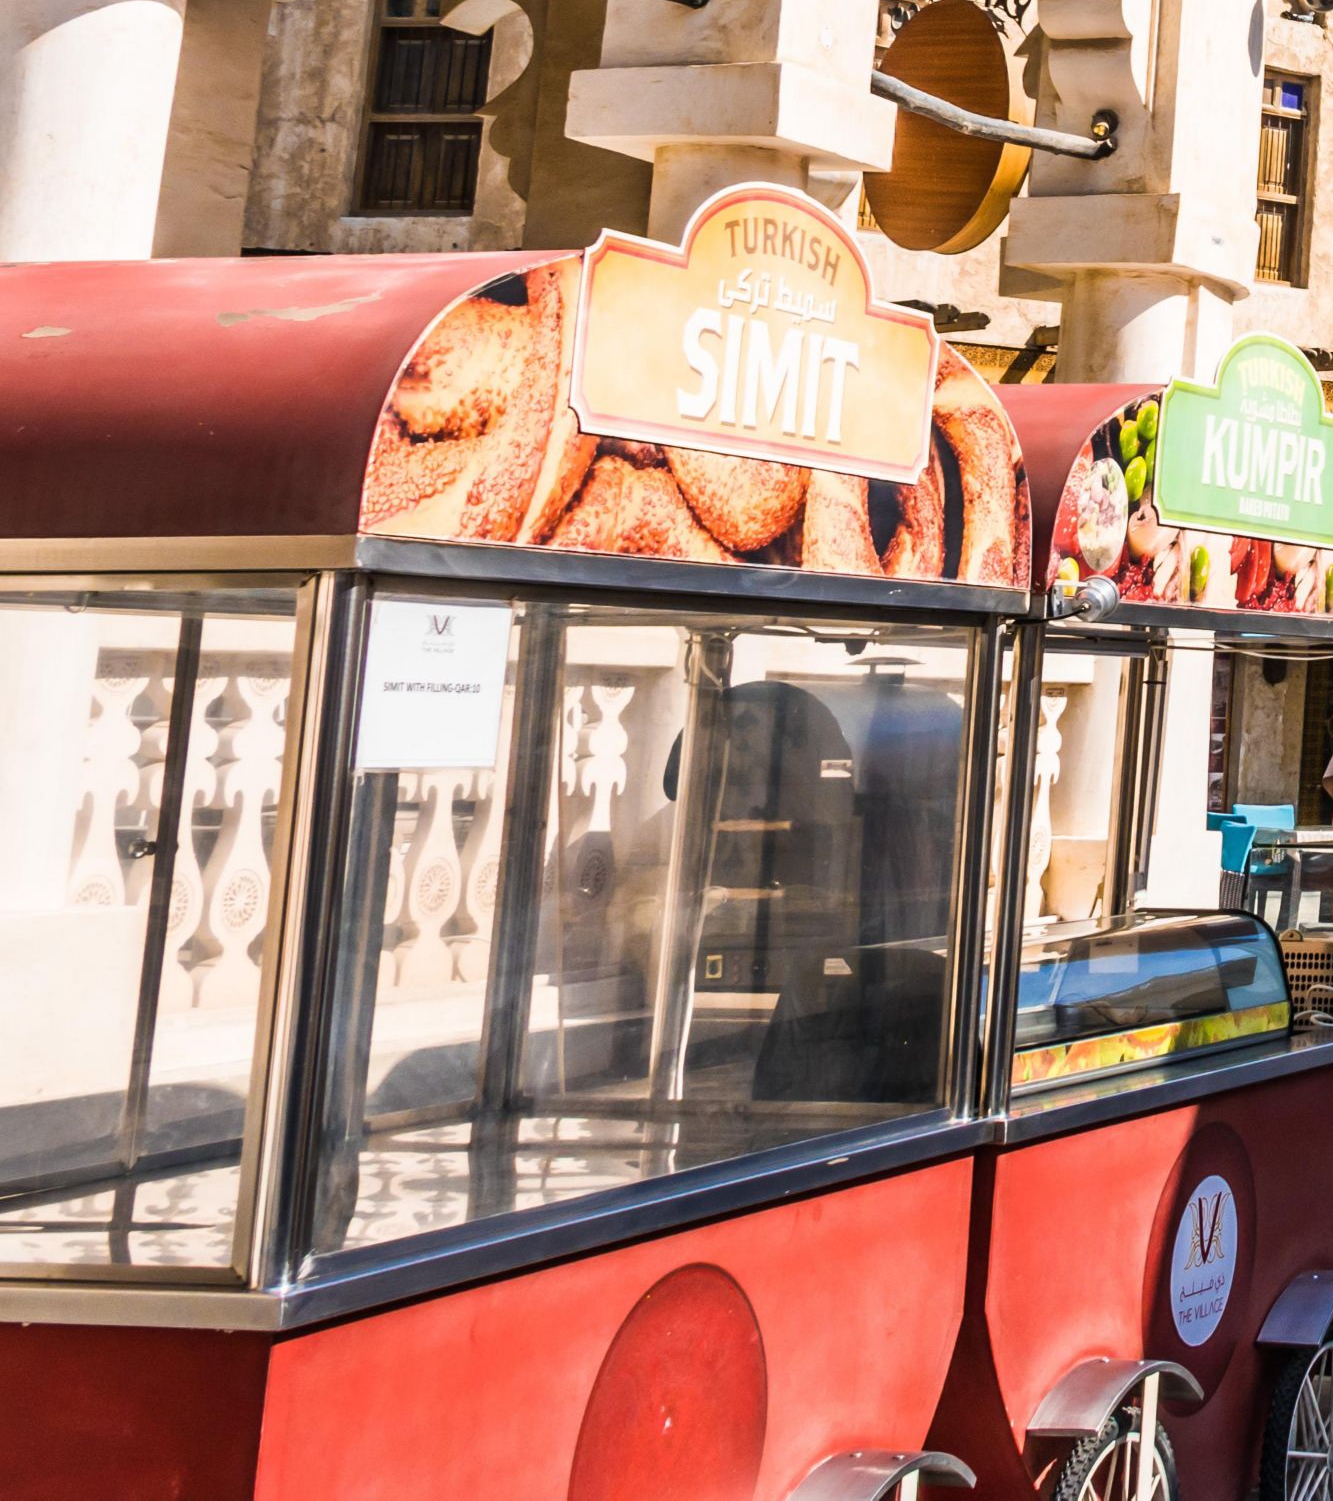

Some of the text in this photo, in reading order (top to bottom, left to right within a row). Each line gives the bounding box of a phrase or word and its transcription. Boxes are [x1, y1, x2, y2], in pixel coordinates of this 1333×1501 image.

[724, 217, 841, 286] TURKISH
[676, 307, 860, 445] SIMIT
[1237, 356, 1307, 406] TURKISH
[1201, 414, 1327, 506] KUMPIR
[384, 682, 405, 693] SIMIT
[406, 682, 425, 693] WITH
[1179, 1297, 1224, 1326] THE VILLAGE
